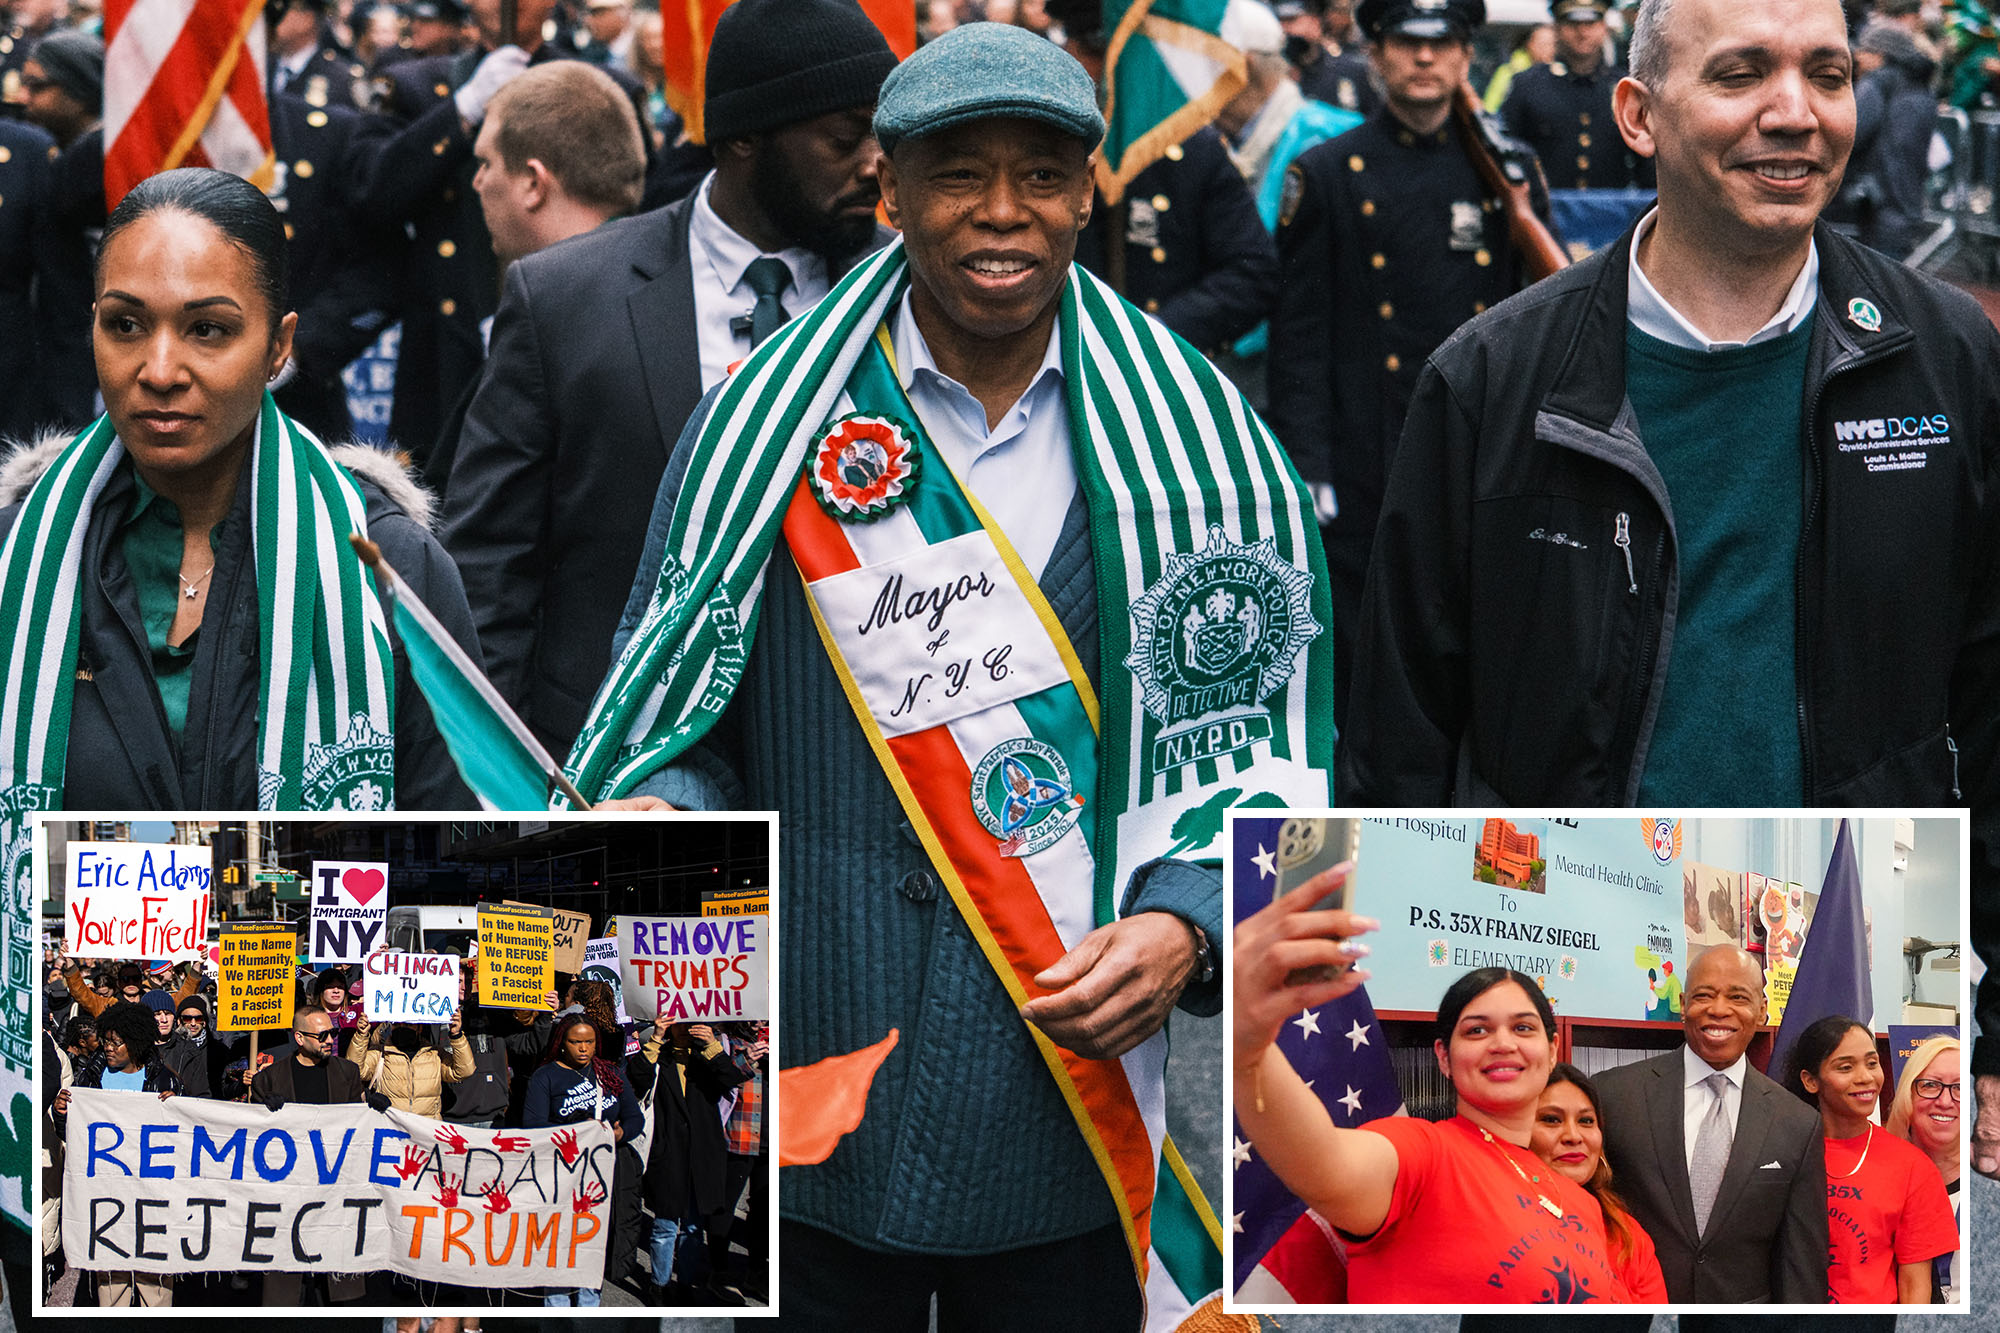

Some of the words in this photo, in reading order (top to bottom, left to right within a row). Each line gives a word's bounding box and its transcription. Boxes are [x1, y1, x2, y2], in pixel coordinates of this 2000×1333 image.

[1834, 418, 1886, 441] NYC
[1887, 414, 1950, 438] DCAS
[1838, 442, 1868, 452] Citywide
[1868, 438, 1918, 450] Administrative
[1918, 436, 1950, 446] Services
[1864, 454, 1887, 464] Louis
[1888, 453, 1898, 462] A.
[1899, 451, 1927, 461] Molina
[1867, 460, 1927, 472] Commissioner
[1175, 565, 1217, 600] NEW
[1220, 562, 1271, 589] YORK
[858, 571, 995, 635] Mayor
[1158, 597, 1179, 630] OF
[1261, 584, 1288, 660] POLICE
[700, 583, 746, 713] TECTIVES
[926, 629, 950, 658] of
[1156, 637, 1174, 680] CITY
[1173, 678, 1253, 718] DETECTIVE
[981, 741, 1023, 771] Patrick's
[1024, 740, 1044, 754] Day
[1044, 745, 1067, 776] Parade
[318, 755, 359, 792] NEW
[365, 752, 392, 769] YO
[973, 770, 987, 801] Saint
[0, 785, 57, 818] ATEST
[974, 802, 996, 828] NYC
[1028, 835, 1053, 852] Since
[1054, 819, 1072, 839] 1762
[1029, 814, 1059, 838] 2025
[1395, 818, 1467, 843] Hospital
[77, 851, 129, 888] Eric
[137, 849, 211, 891] Adams
[1555, 854, 1595, 880] Mental
[1598, 865, 1634, 889] Health
[1636, 875, 1664, 895] Clinic
[317, 868, 340, 906] I
[713, 889, 769, 899] RefuseFascism.org
[312, 907, 385, 919] IMMIGRANT
[489, 904, 542, 916] RefuseFascism.org
[706, 906, 715, 916] In
[725, 905, 740, 915] the
[743, 902, 769, 914] Nam
[1499, 893, 1517, 913] To
[71, 896, 138, 953] You're
[141, 893, 208, 956] Fired!
[482, 918, 493, 929] In
[500, 919, 514, 931] the
[517, 921, 549, 934] Name
[632, 919, 756, 956] REMOVE
[1409, 906, 1446, 931] P.S.
[1449, 912, 1483, 936] 35X
[1485, 918, 1544, 944] FRANZ
[1546, 927, 1600, 951] SIEGEL
[224, 940, 235, 951] In
[239, 940, 258, 951] the
[261, 939, 292, 951] Name
[315, 919, 383, 959] NY
[481, 932, 493, 943] of
[496, 933, 552, 950] Humanity,
[553, 933, 573, 949] SM
[585, 943, 613, 954] GRANTS
[222, 955, 234, 966] of
[238, 954, 293, 967] Humanity,
[367, 952, 455, 976] CHINGA
[485, 946, 502, 958] We
[505, 948, 548, 962] REFUSE
[597, 950, 618, 960] YORK!
[1454, 947, 1556, 975] ELEMENTARY
[225, 970, 244, 981] We
[247, 968, 289, 981] REFUSE
[490, 961, 502, 972] to
[504, 963, 544, 977] Accept
[629, 954, 750, 991] TRUMP'S
[231, 985, 242, 996] to
[245, 983, 284, 997] Accept
[399, 976, 418, 990] TU
[491, 978, 499, 987] a
[502, 976, 542, 990] Fascist
[231, 1002, 238, 1011] a
[242, 998, 282, 1011] Fascist
[374, 990, 454, 1017] MIGRA
[492, 990, 542, 1005] America!
[656, 989, 743, 1019] PAWN!
[231, 1013, 281, 1026] America!
[86, 1122, 411, 1187] REMOVE
[413, 1143, 613, 1204] ADAMS
[88, 1197, 384, 1263] REJECT
[401, 1205, 601, 1268] TRUMP
[1829, 1207, 1869, 1264] OCIATION
